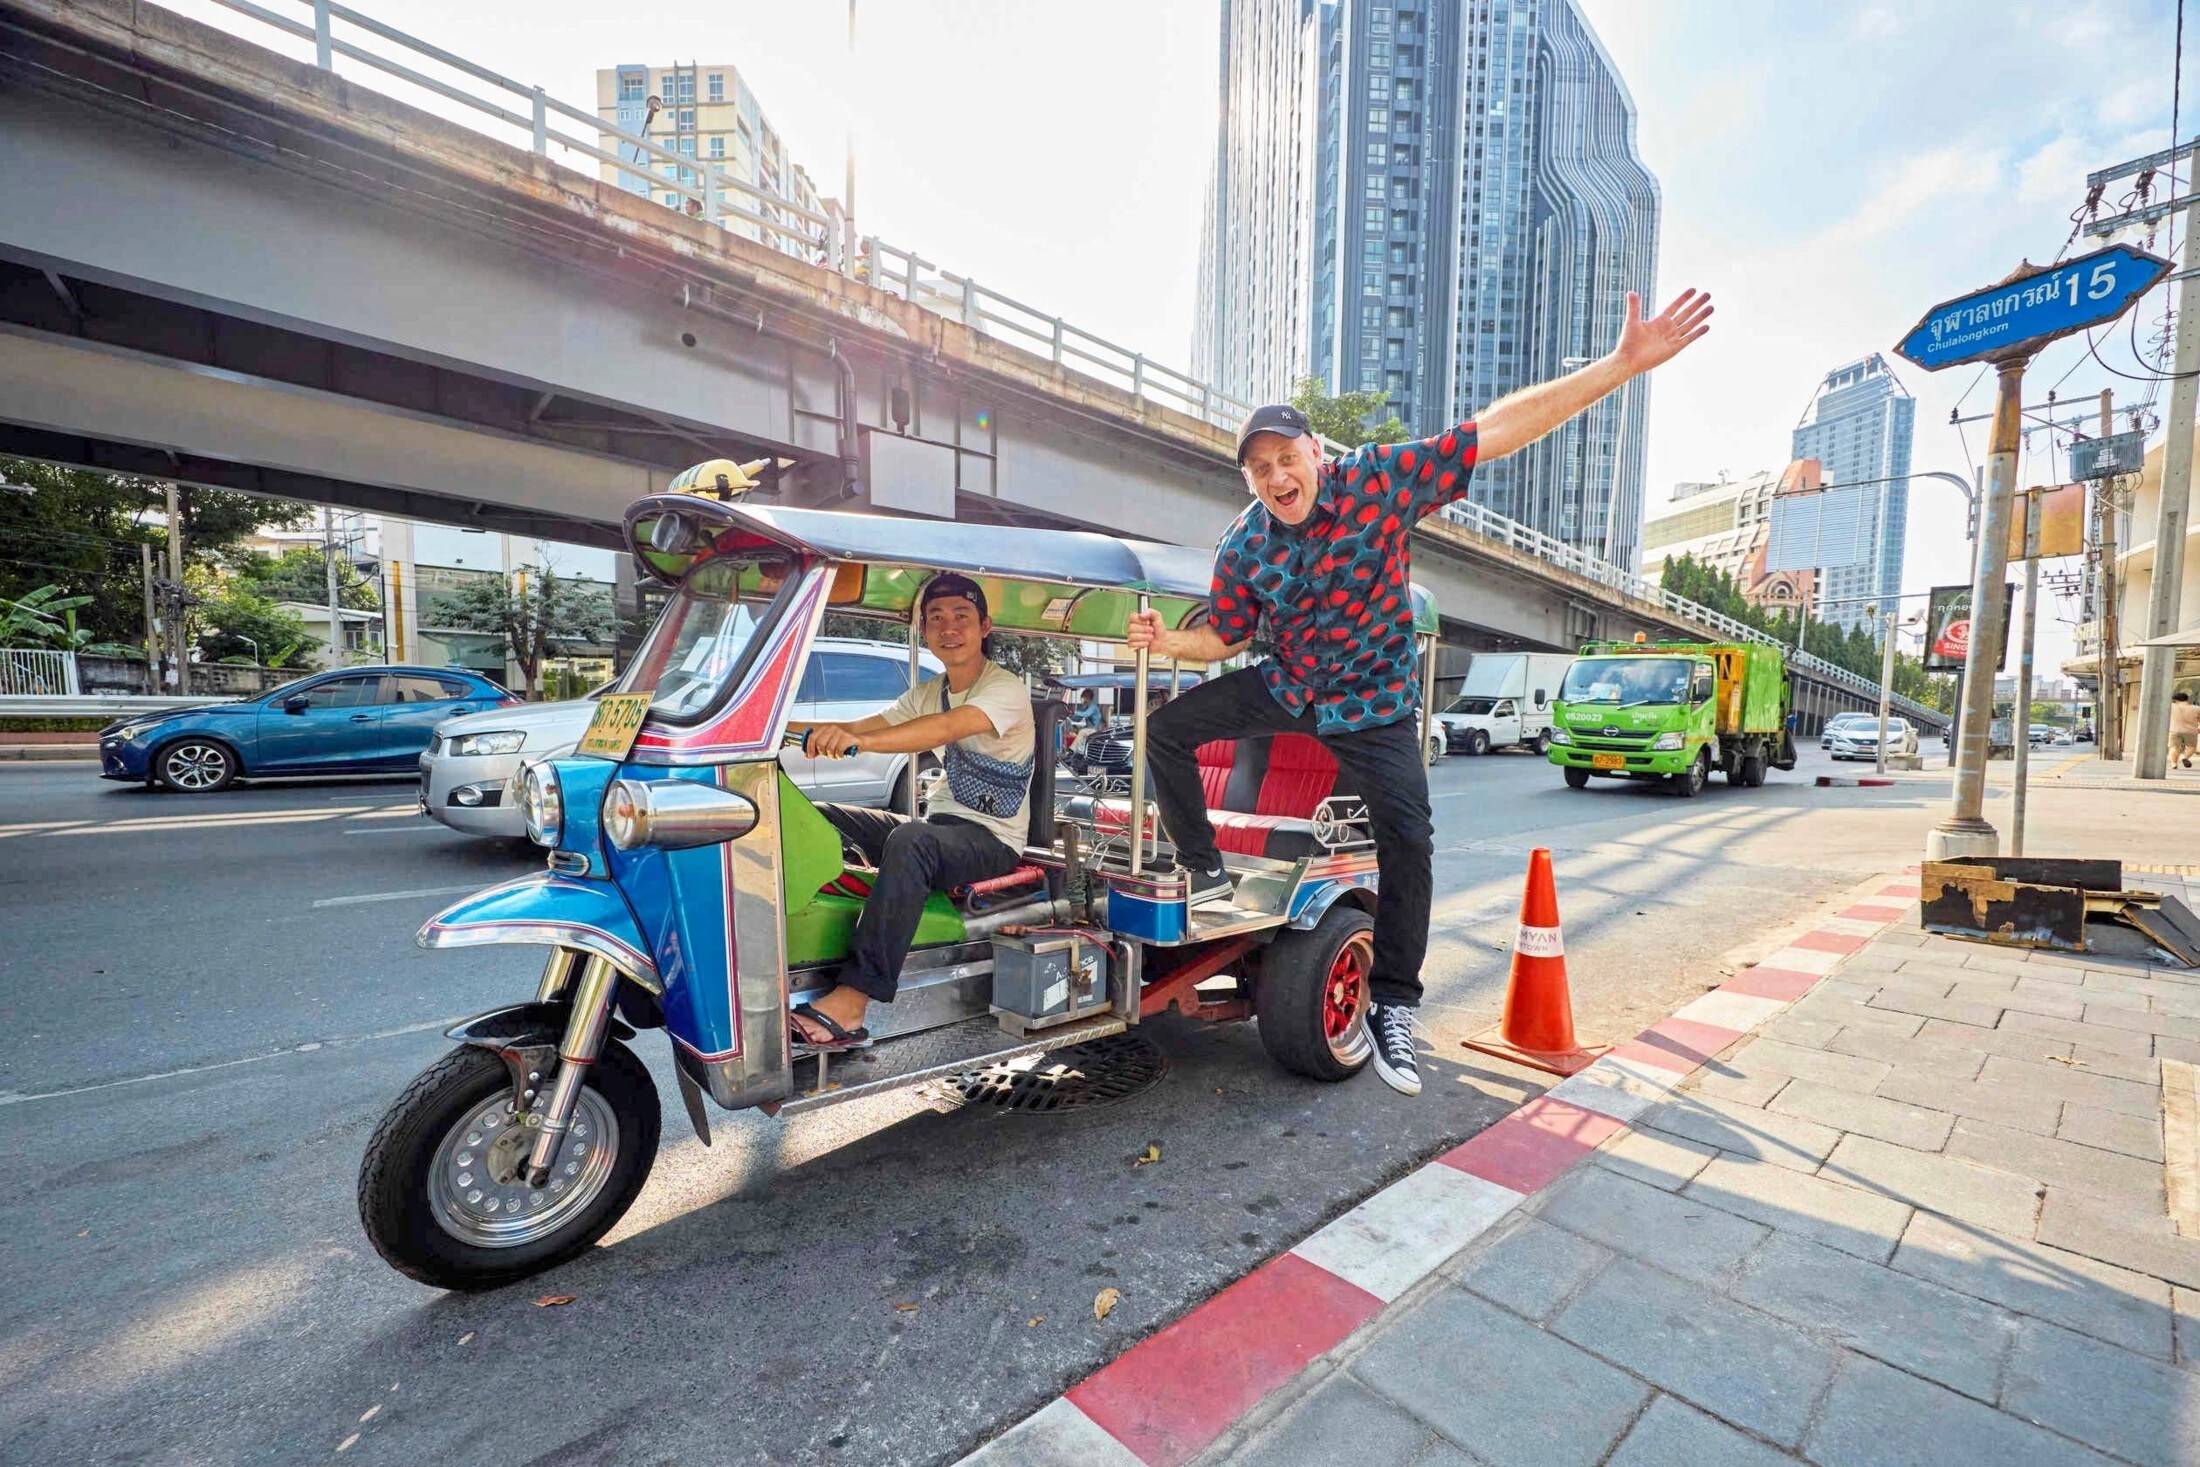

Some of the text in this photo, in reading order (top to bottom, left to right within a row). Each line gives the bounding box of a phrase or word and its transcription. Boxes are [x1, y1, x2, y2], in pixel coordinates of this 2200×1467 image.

[1930, 260, 2117, 341] จุฬาลงกรณ์ 15
[1927, 322, 2009, 353] Chulalongkorn
[1943, 642, 1968, 652] SING
